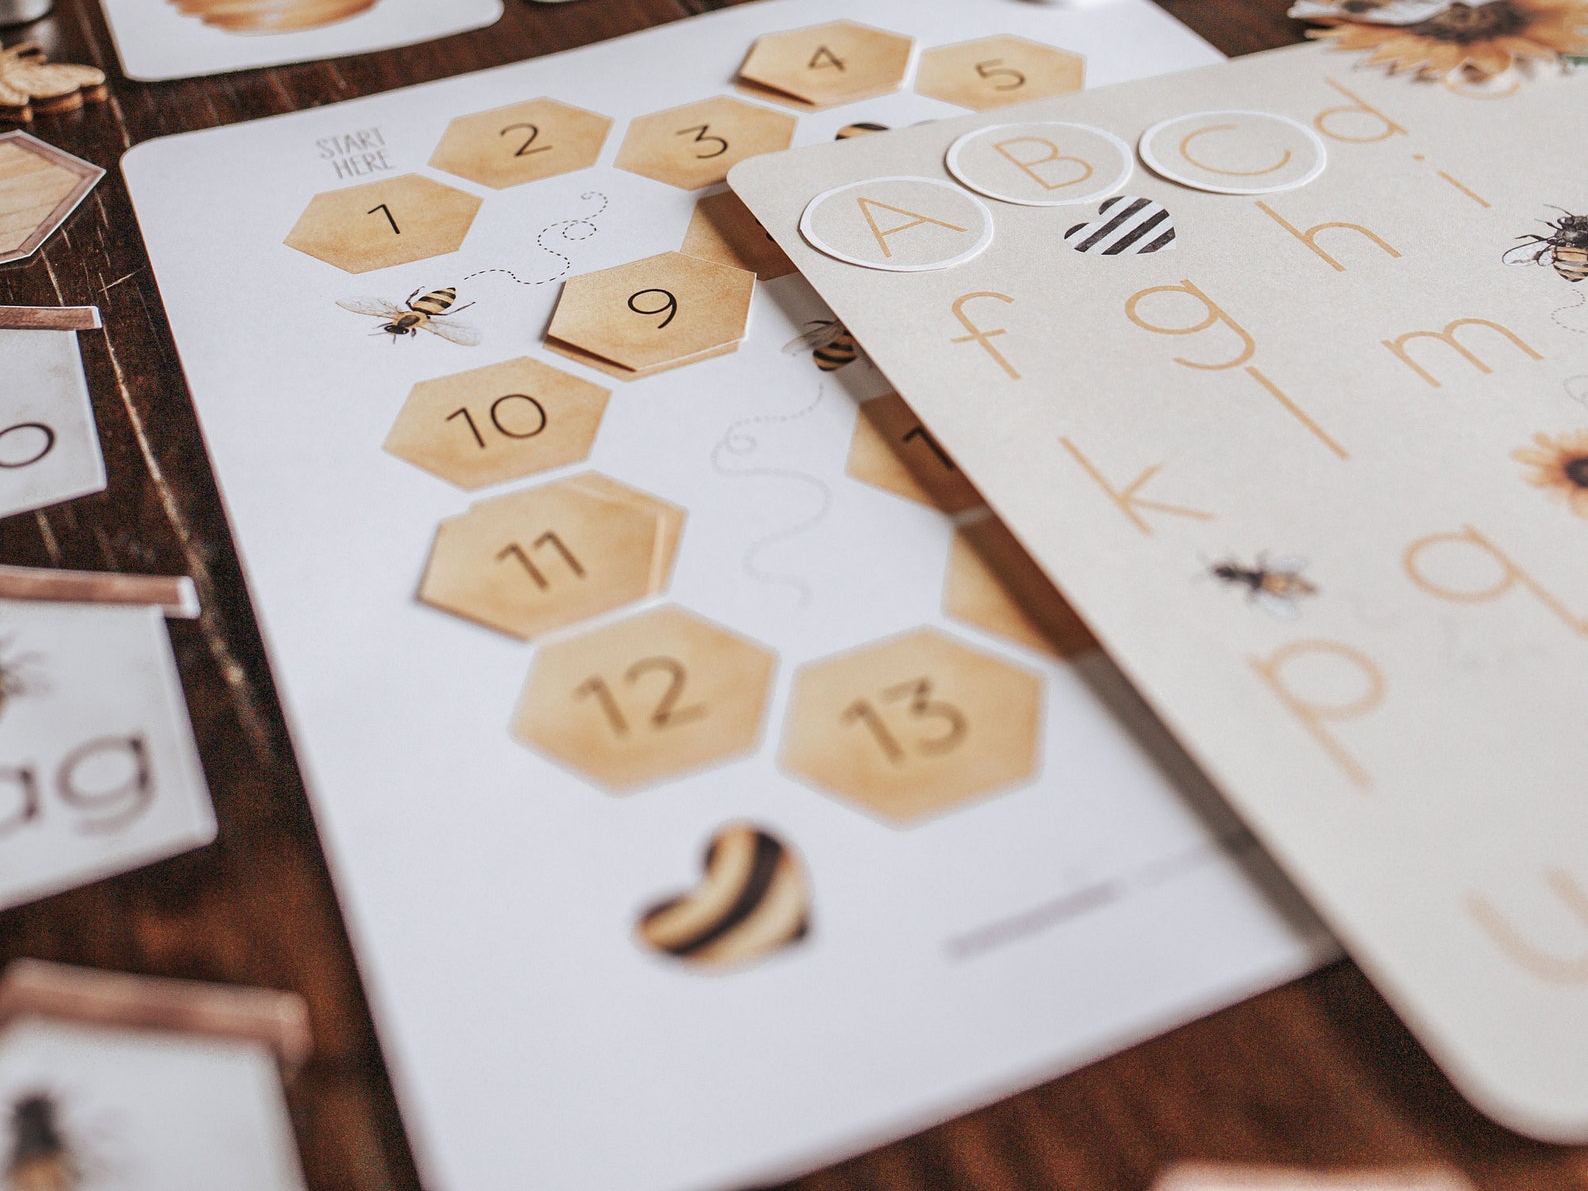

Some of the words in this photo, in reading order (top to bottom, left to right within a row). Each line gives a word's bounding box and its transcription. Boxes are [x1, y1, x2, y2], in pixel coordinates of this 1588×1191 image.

[807, 45, 847, 74] 4
[974, 58, 1027, 92] 5
[314, 126, 387, 161] START
[332, 151, 396, 181] HERE
[500, 122, 553, 158] 2
[675, 124, 729, 160] 3
[857, 197, 969, 259] A
[993, 135, 1094, 192] B
[1179, 124, 1292, 178] C
[1313, 77, 1411, 144] d
[367, 203, 401, 236] 1
[950, 290, 1023, 380] f
[1124, 279, 1256, 371] g
[1253, 200, 1403, 273] h
[1412, 153, 1493, 209] i
[626, 287, 679, 331] 9
[445, 392, 549, 450] 10
[1057, 435, 1216, 537] k
[1380, 316, 1545, 389] m
[494, 528, 588, 593] 11
[1246, 638, 1391, 791] p
[1403, 522, 1588, 640] q
[572, 653, 713, 743] 12
[838, 674, 971, 769] 13
